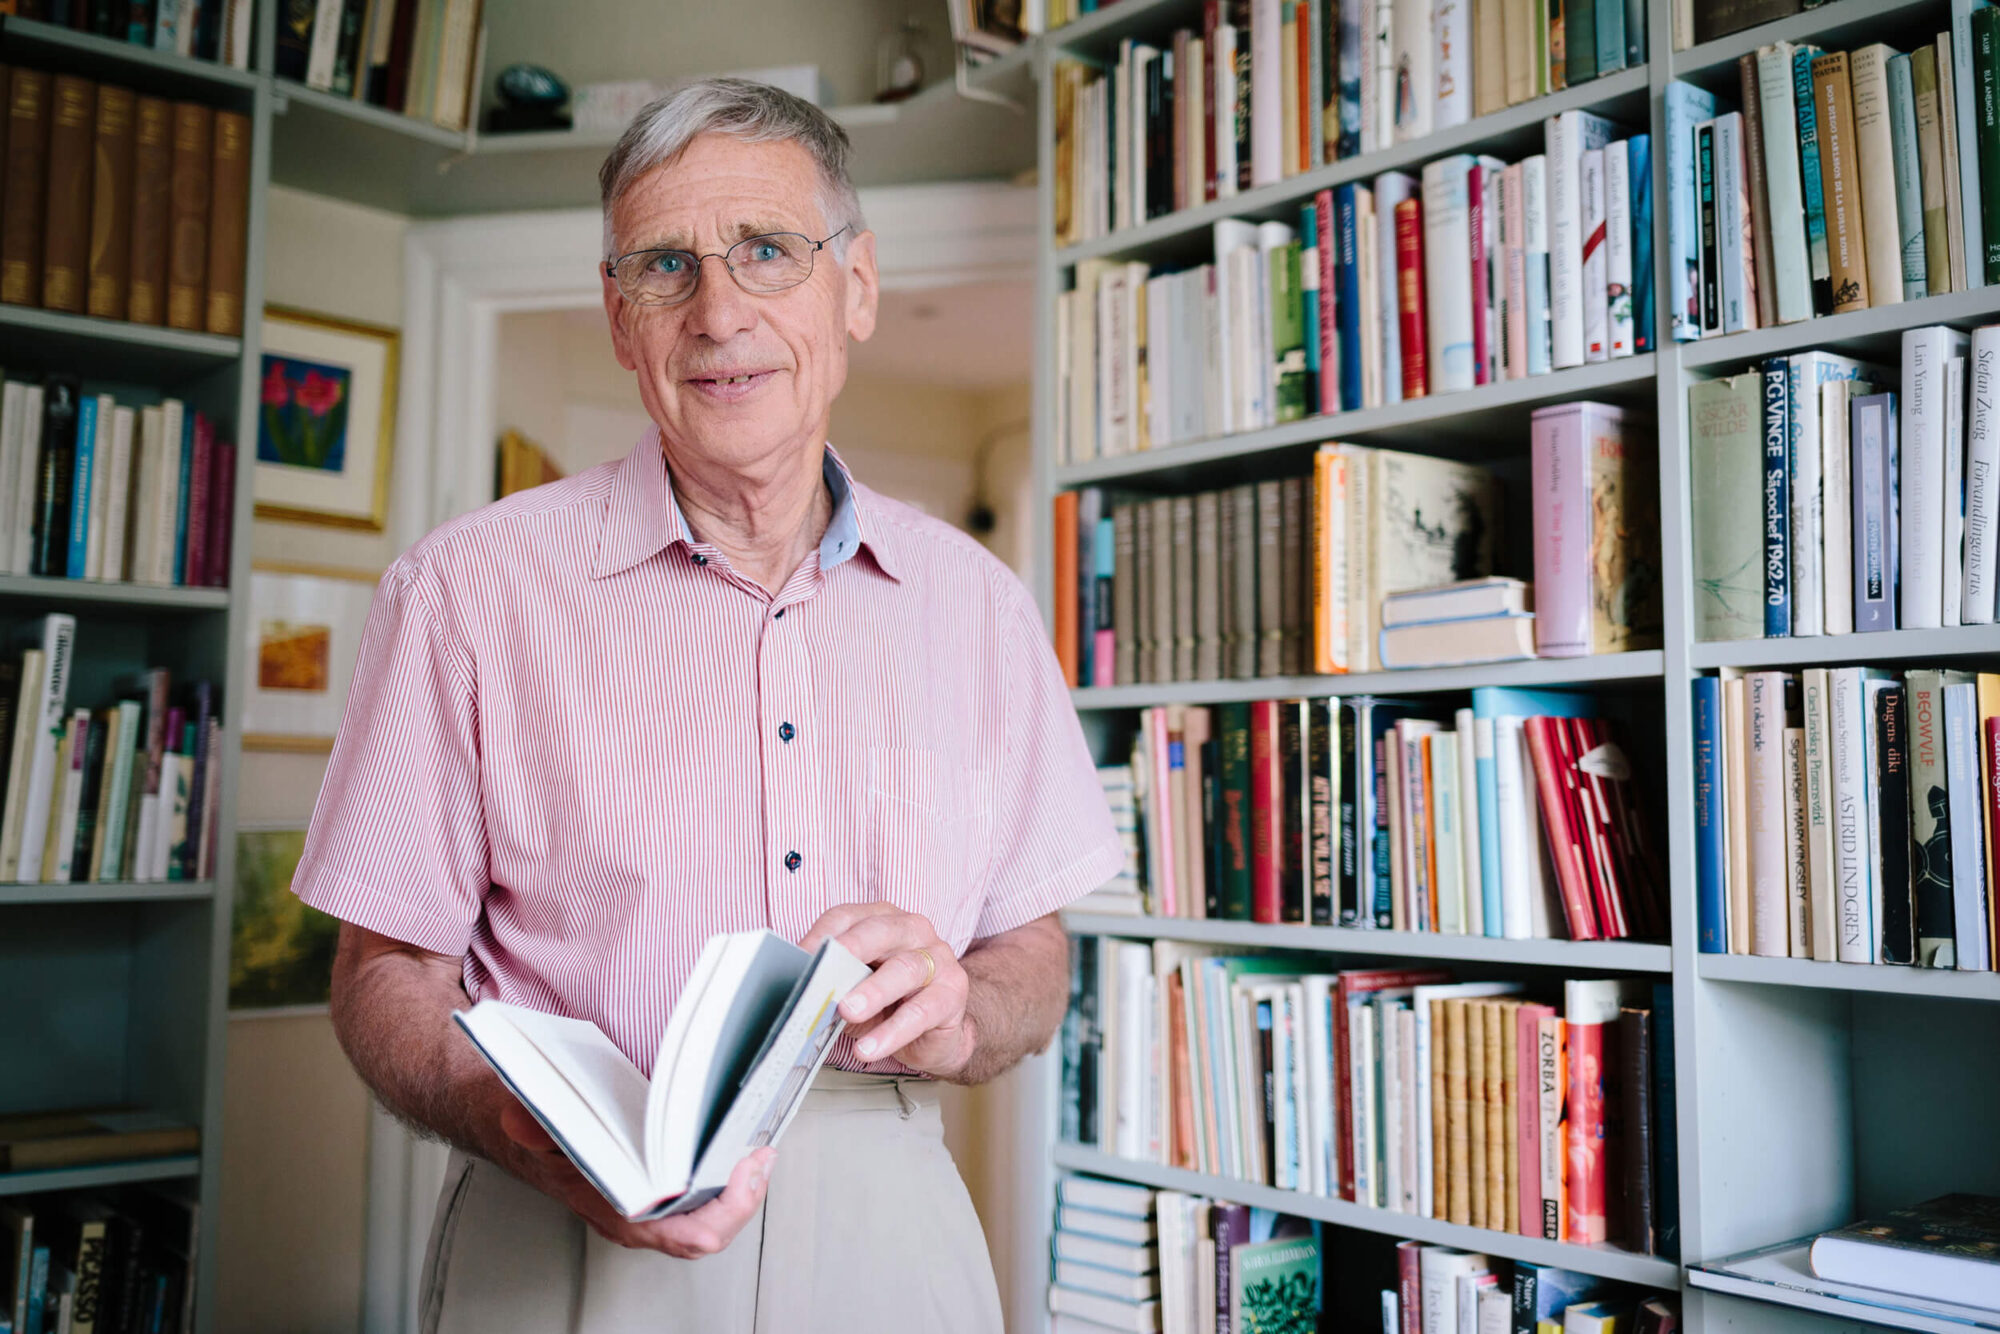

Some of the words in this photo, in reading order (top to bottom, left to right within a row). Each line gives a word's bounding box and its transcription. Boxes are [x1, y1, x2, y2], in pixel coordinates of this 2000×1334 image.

[1813, 55, 1842, 70] EVERT
[1982, 33, 1991, 55] TAUBE
[1794, 52, 1810, 99] EVERT
[1814, 66, 1843, 78] TAUBE
[1983, 69, 1992, 83] BLÅ
[1826, 84, 1835, 103] DON
[1984, 85, 1994, 126] ANEMONER
[1800, 101, 1816, 148] TAUBE
[1827, 105, 1837, 133] DIEGO
[1830, 135, 1842, 179] KARLSSON
[1835, 180, 1843, 193] DE
[1835, 194, 1844, 204] LA
[1837, 207, 1846, 234] ROSAS
[1838, 236, 1849, 268] ROMAN
[1913, 343, 1927, 367] Lin
[1976, 349, 1993, 394] Stefan
[1911, 370, 1927, 416] Yutang
[1696, 404, 1749, 423] OSCAR
[1698, 420, 1748, 439] WILDE
[1766, 370, 1783, 457] P.G.VINGE
[1974, 397, 1992, 441] Zweig
[1913, 422, 1927, 476] Konsten
[1765, 468, 1783, 541] Säpochef
[1913, 479, 1926, 497] att
[1969, 459, 1990, 570] Förvandlingens
[1767, 543, 1785, 606] 1962-70
[1869, 552, 1880, 595] JOHANNA
[1969, 572, 1982, 597] rus
[1753, 678, 1764, 705] Den
[1806, 686, 1818, 712] Claes
[1833, 678, 1848, 729] Margareta
[1753, 707, 1764, 752] okände
[1806, 712, 1819, 756] Lindskog
[1882, 694, 1901, 743] Dagens
[1916, 690, 1935, 767] BEOWVLF
[1788, 738, 1801, 770] Signe
[1838, 730, 1851, 784] Strömstedt
[1887, 747, 1902, 774] dikt
[1313, 776, 1329, 802] ATT
[1808, 759, 1822, 799] Piratens
[1313, 803, 1329, 831] INTE
[1793, 807, 1804, 843] MARY
[1839, 791, 1857, 853] ASTRID
[1314, 832, 1330, 876] VILJA
[1794, 844, 1807, 901] KINGSLEY
[1843, 856, 1861, 948] LINDGREN
[1541, 1032, 1557, 1094] ZORBA
[1544, 1201, 1558, 1239] FABER
[74, 1237, 104, 1323] PICASSO
[1523, 1276, 1536, 1310] Sture
